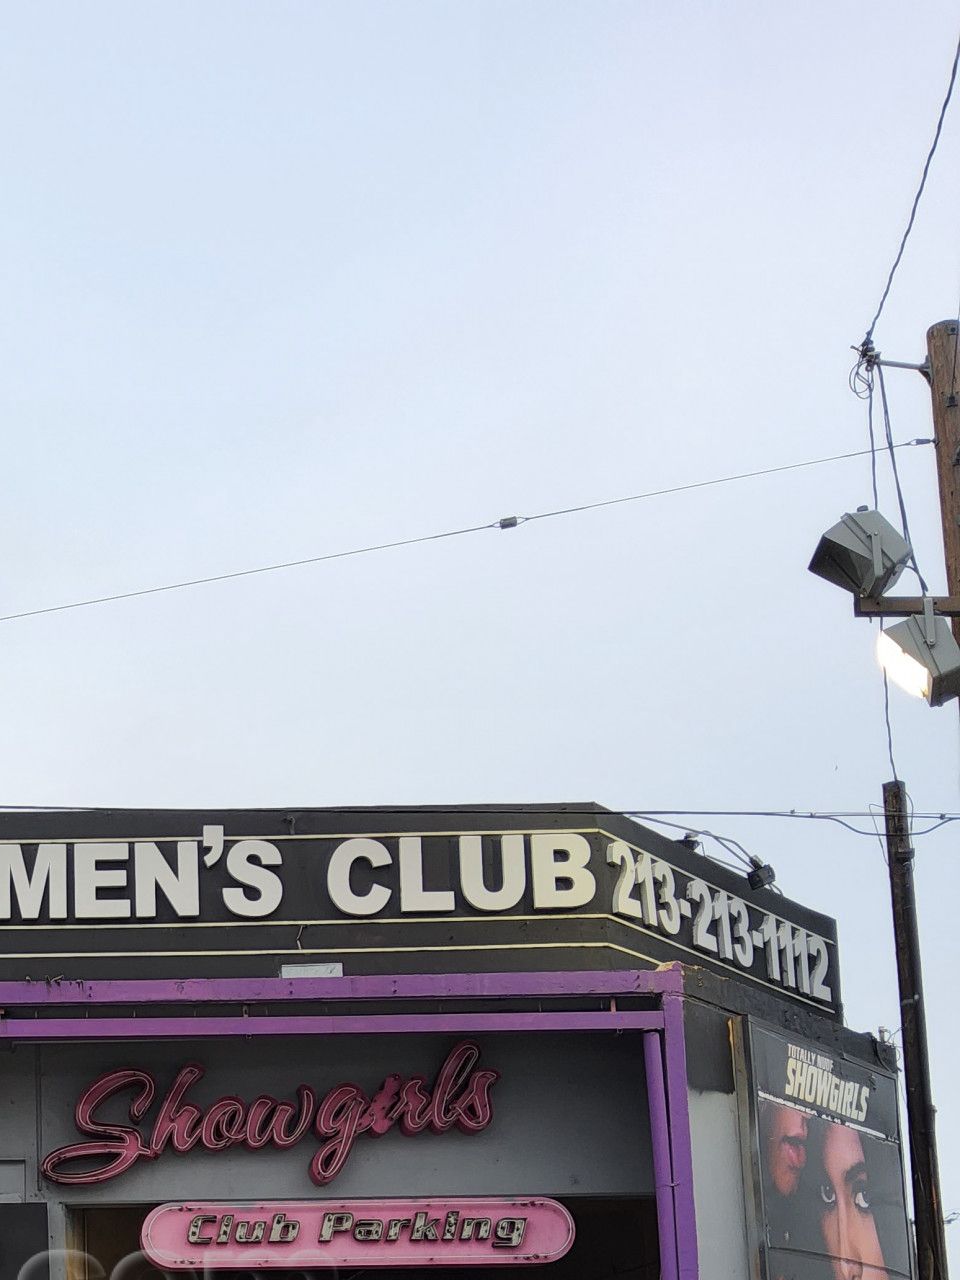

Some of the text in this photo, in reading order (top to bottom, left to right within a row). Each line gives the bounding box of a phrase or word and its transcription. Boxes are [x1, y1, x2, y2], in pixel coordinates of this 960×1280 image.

[327, 827, 597, 917] CLUB
[606, 840, 833, 1002] 213-213-1112
[785, 1058, 870, 1123] SHOWGIRLS
[787, 1044, 816, 1065] TOTALLY
[41, 1041, 501, 1187] Showgirls
[187, 1209, 528, 1248] Club Parking
